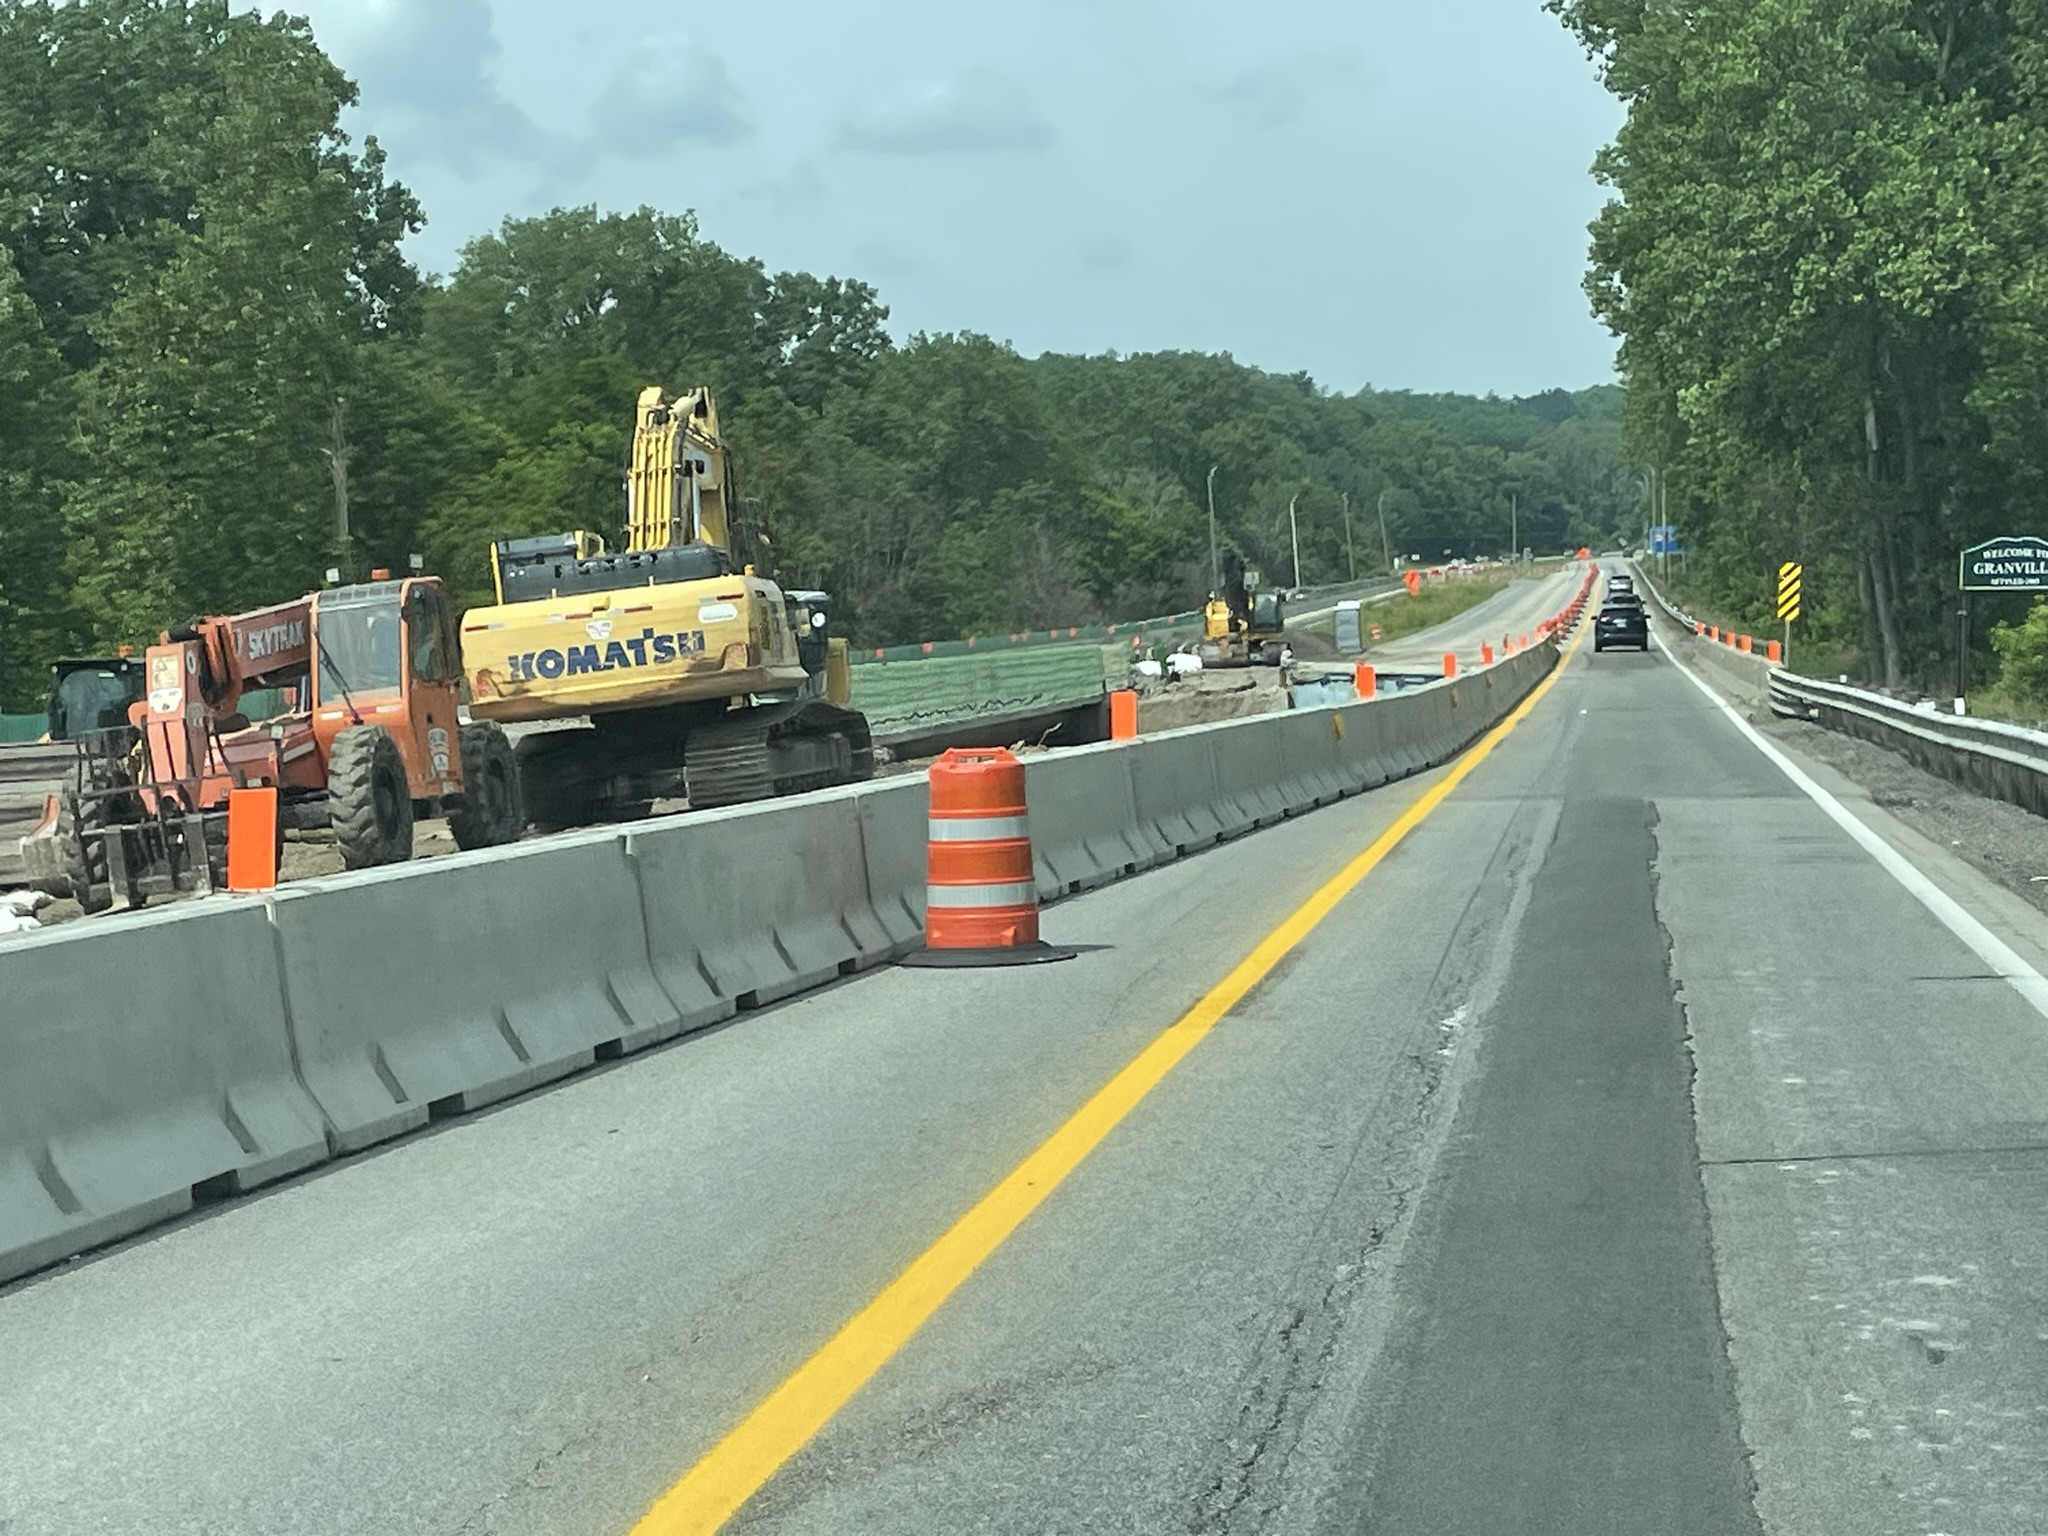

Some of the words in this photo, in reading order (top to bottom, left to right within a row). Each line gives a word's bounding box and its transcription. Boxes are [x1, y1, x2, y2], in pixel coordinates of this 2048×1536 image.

[1983, 548, 2034, 559] WELCOME
[1973, 561, 2048, 574] GRANVILL
[248, 620, 305, 660] SKYTRAK
[508, 628, 705, 681] KOMATSU
